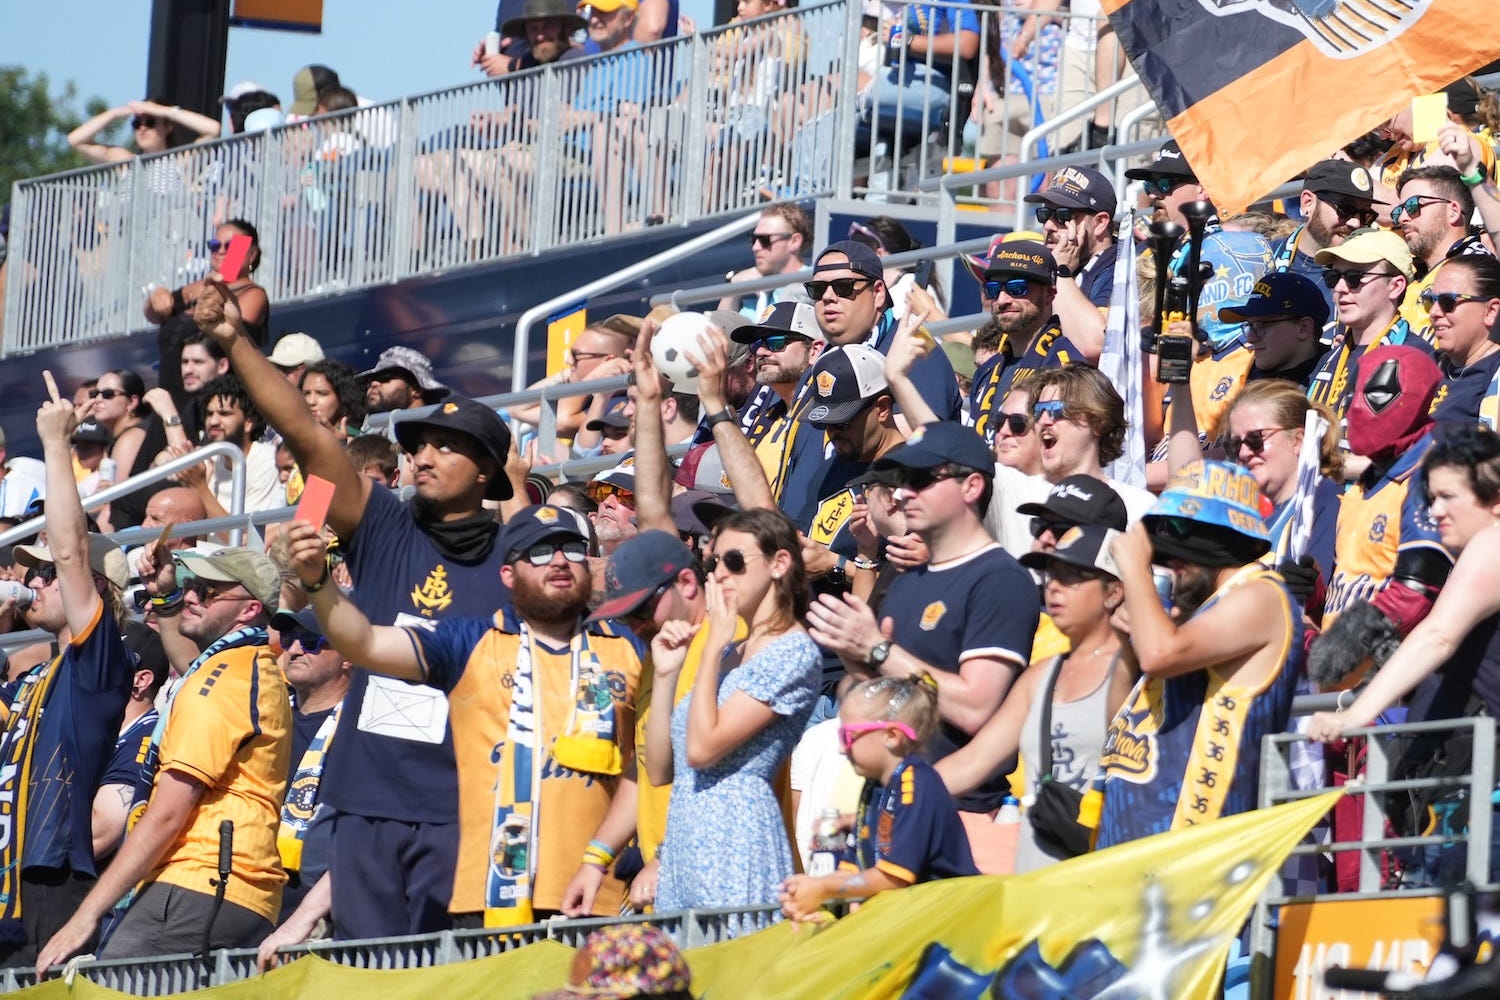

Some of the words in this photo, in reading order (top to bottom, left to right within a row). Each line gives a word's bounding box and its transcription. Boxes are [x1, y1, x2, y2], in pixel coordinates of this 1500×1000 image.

[997, 249, 1030, 262] Anchors
[1032, 253, 1044, 266] Up
[1233, 272, 1255, 298] FC
